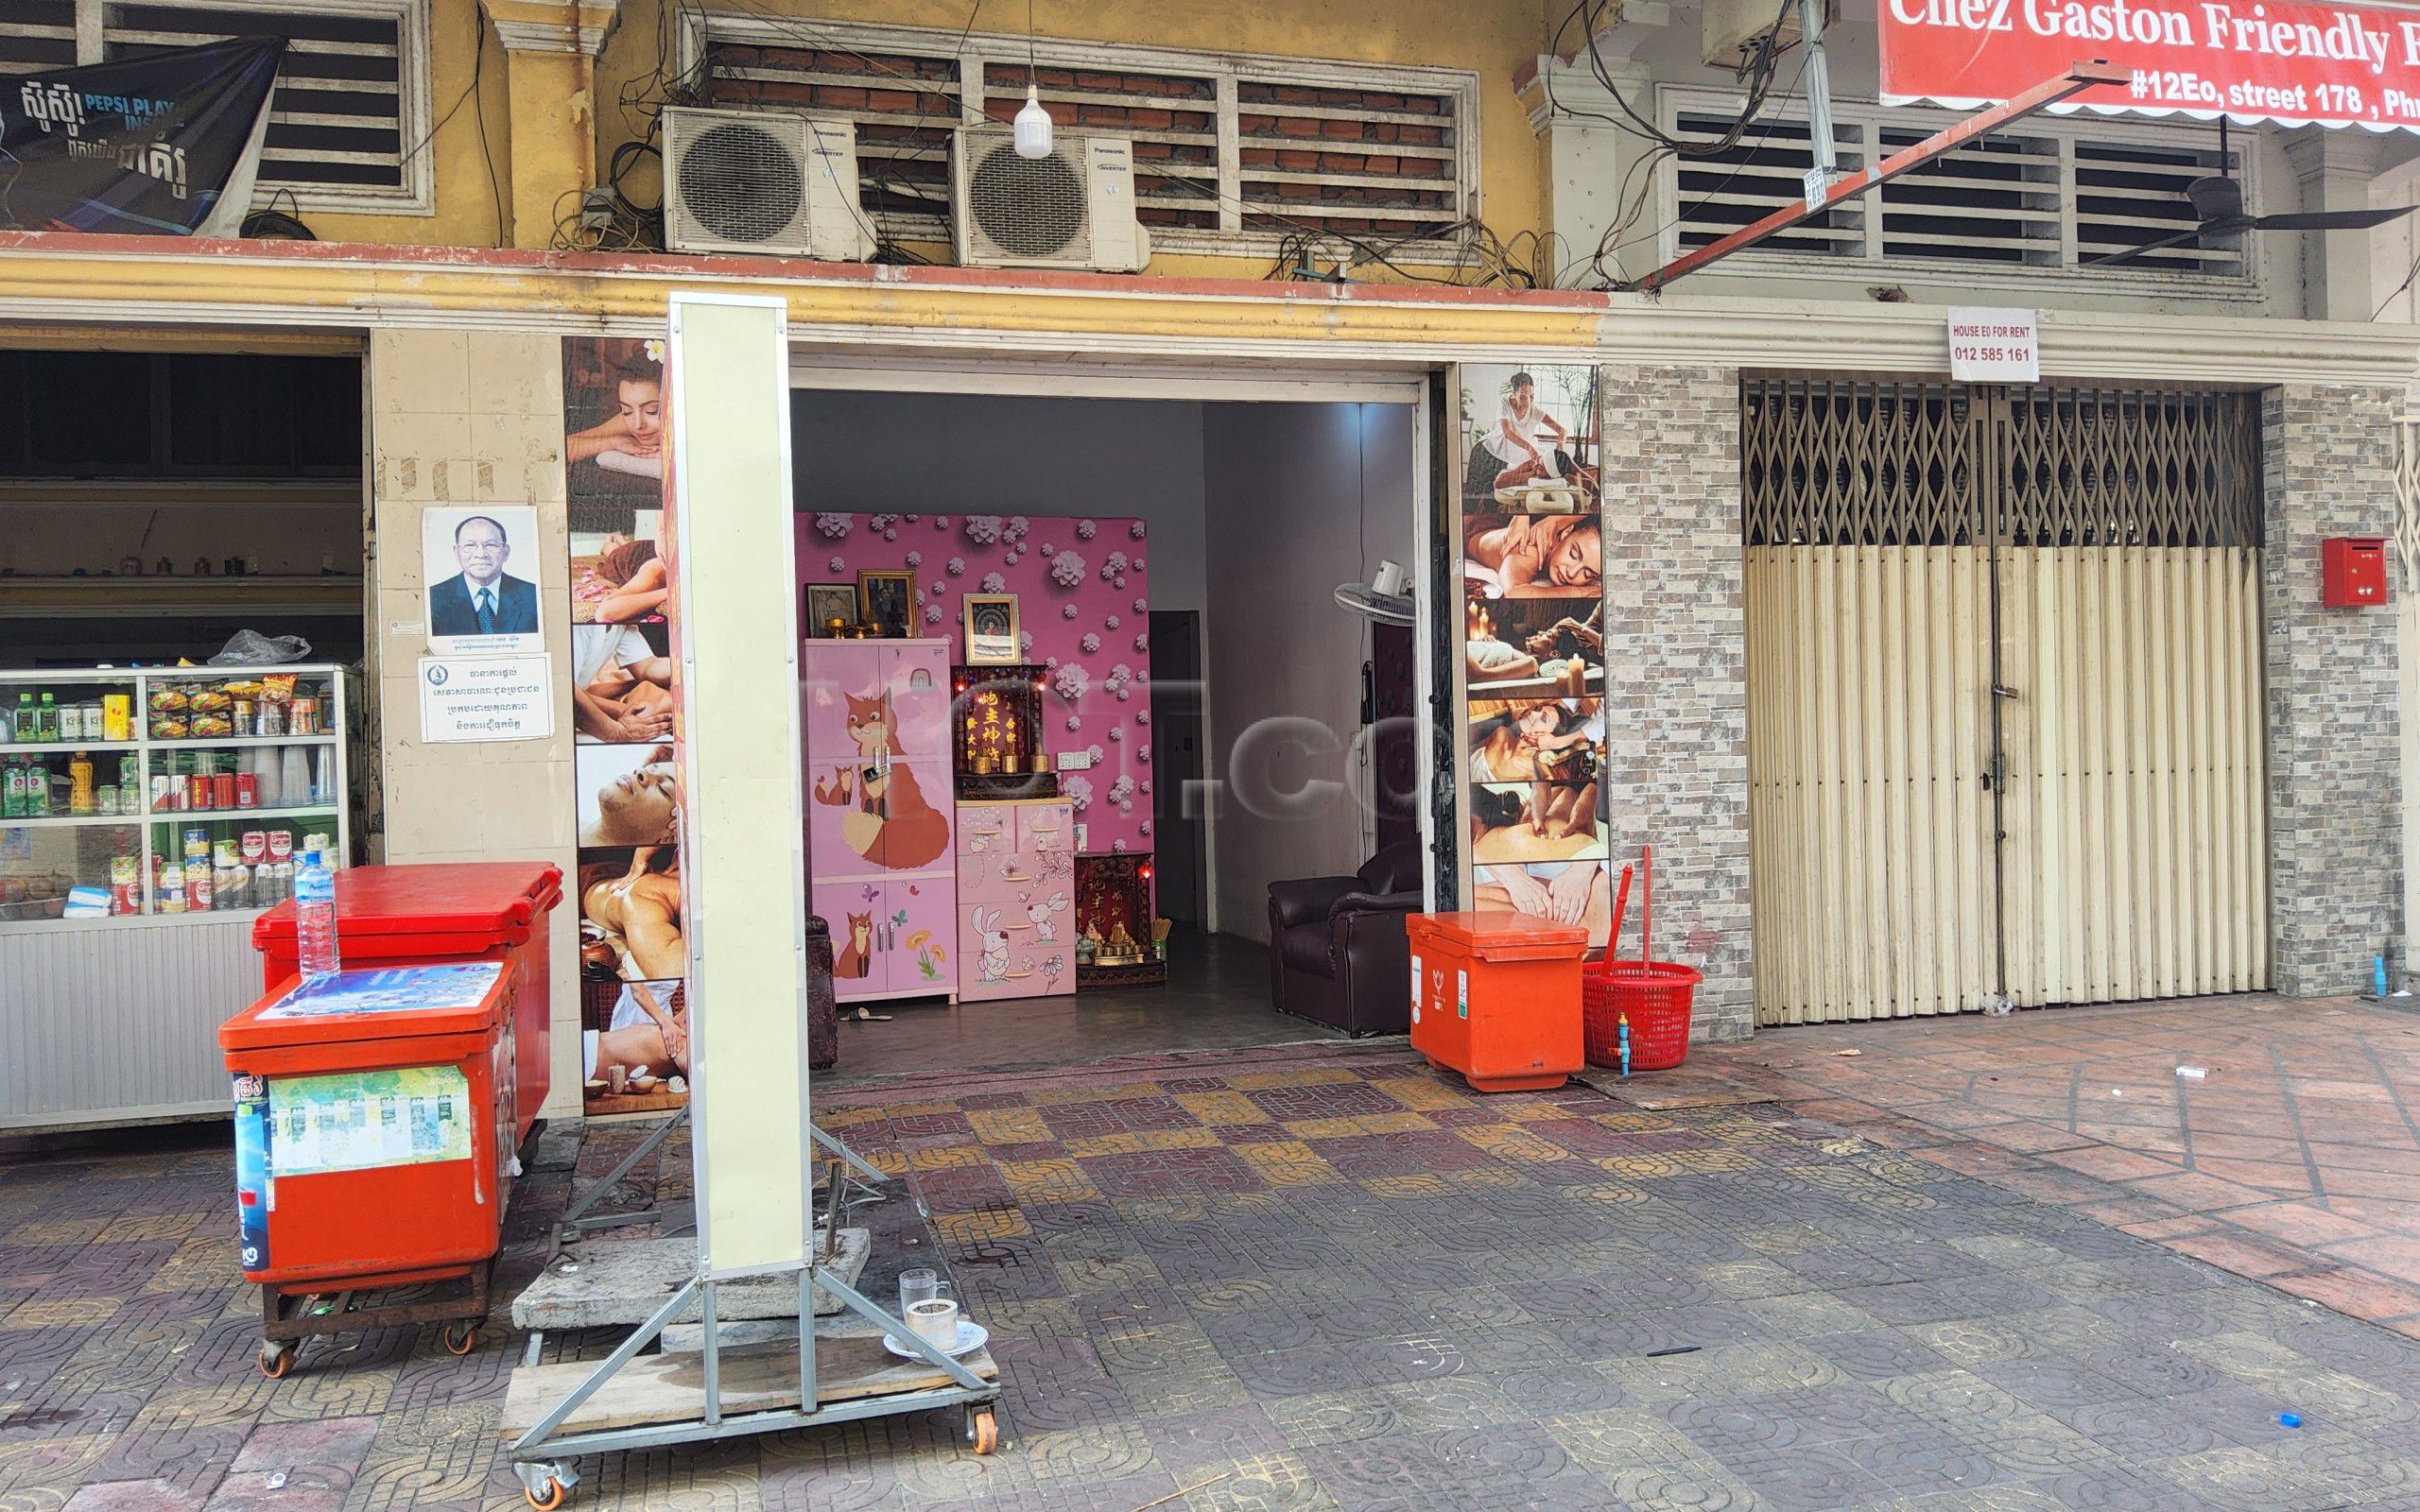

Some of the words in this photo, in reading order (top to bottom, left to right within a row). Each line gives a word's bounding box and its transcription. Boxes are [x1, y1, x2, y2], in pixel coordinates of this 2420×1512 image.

[2024, 0, 2195, 46] Gaston
[2201, 3, 2390, 75] Friendly
[85, 93, 130, 114] PEPSI
[131, 97, 176, 117] PLAY
[2229, 80, 2308, 112] street
[2315, 84, 2362, 113] 178
[1094, 146, 1126, 155] Panasonic
[1953, 325, 1979, 337] HOUSE
[1993, 326, 2008, 337] FOR
[2010, 326, 2031, 338] RENT
[1955, 347, 1978, 360] 012
[1980, 347, 2003, 361] 585
[2007, 348, 2030, 361] 161
